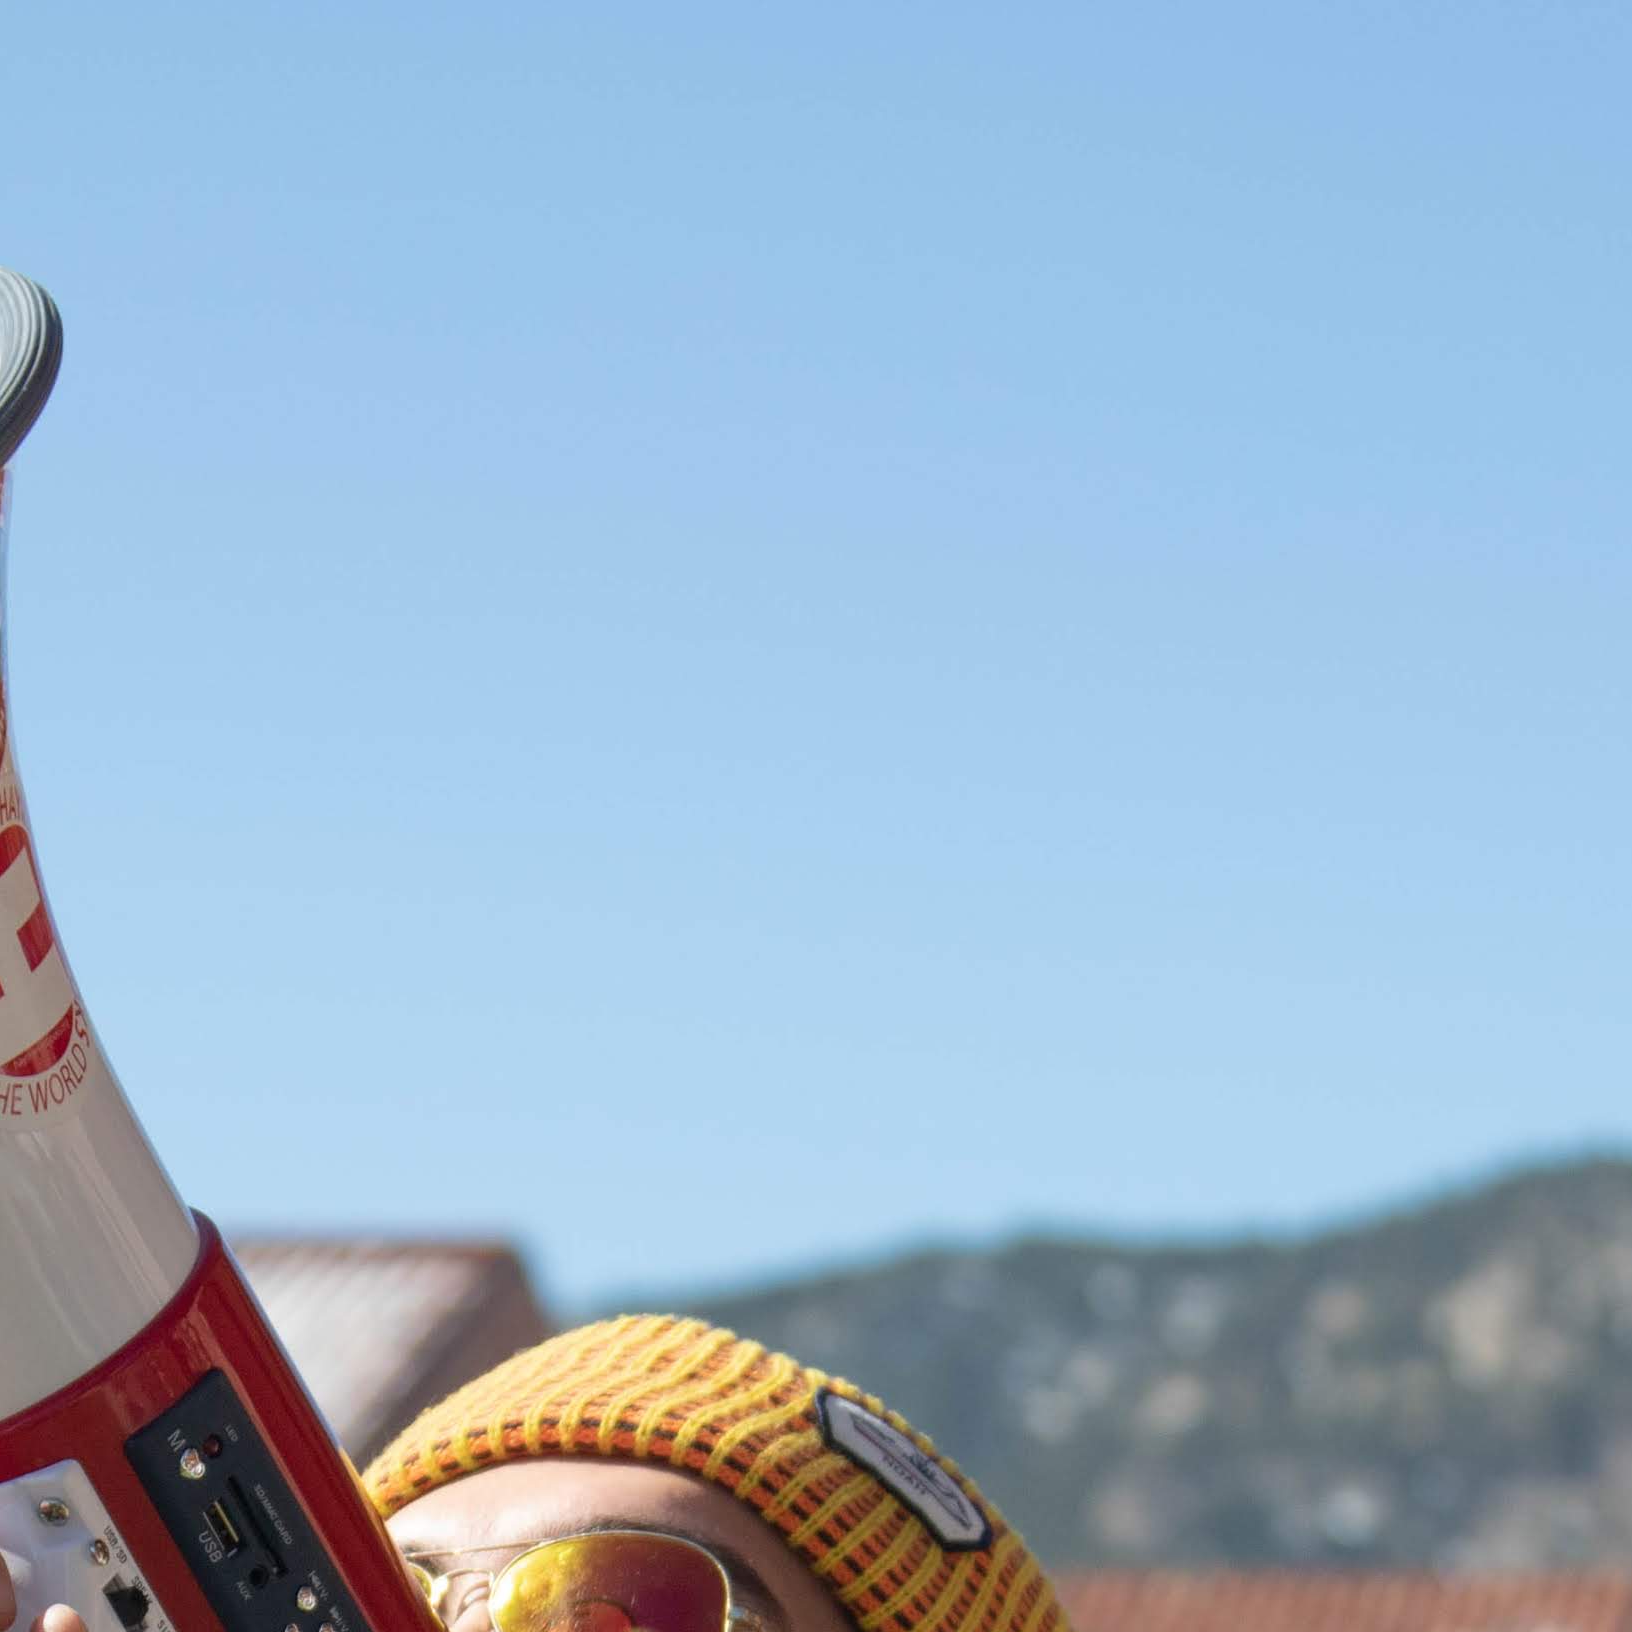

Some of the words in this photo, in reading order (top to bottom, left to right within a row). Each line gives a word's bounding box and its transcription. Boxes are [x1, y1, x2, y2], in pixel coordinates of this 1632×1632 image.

[28, 1042, 88, 1115] WORLD
[167, 1428, 187, 1452] M
[225, 1424, 239, 1441] LED
[103, 1525, 128, 1564] USB/SD
[274, 1520, 293, 1545] CARD
[198, 1530, 224, 1563] USB
[236, 1581, 254, 1600] AUX
